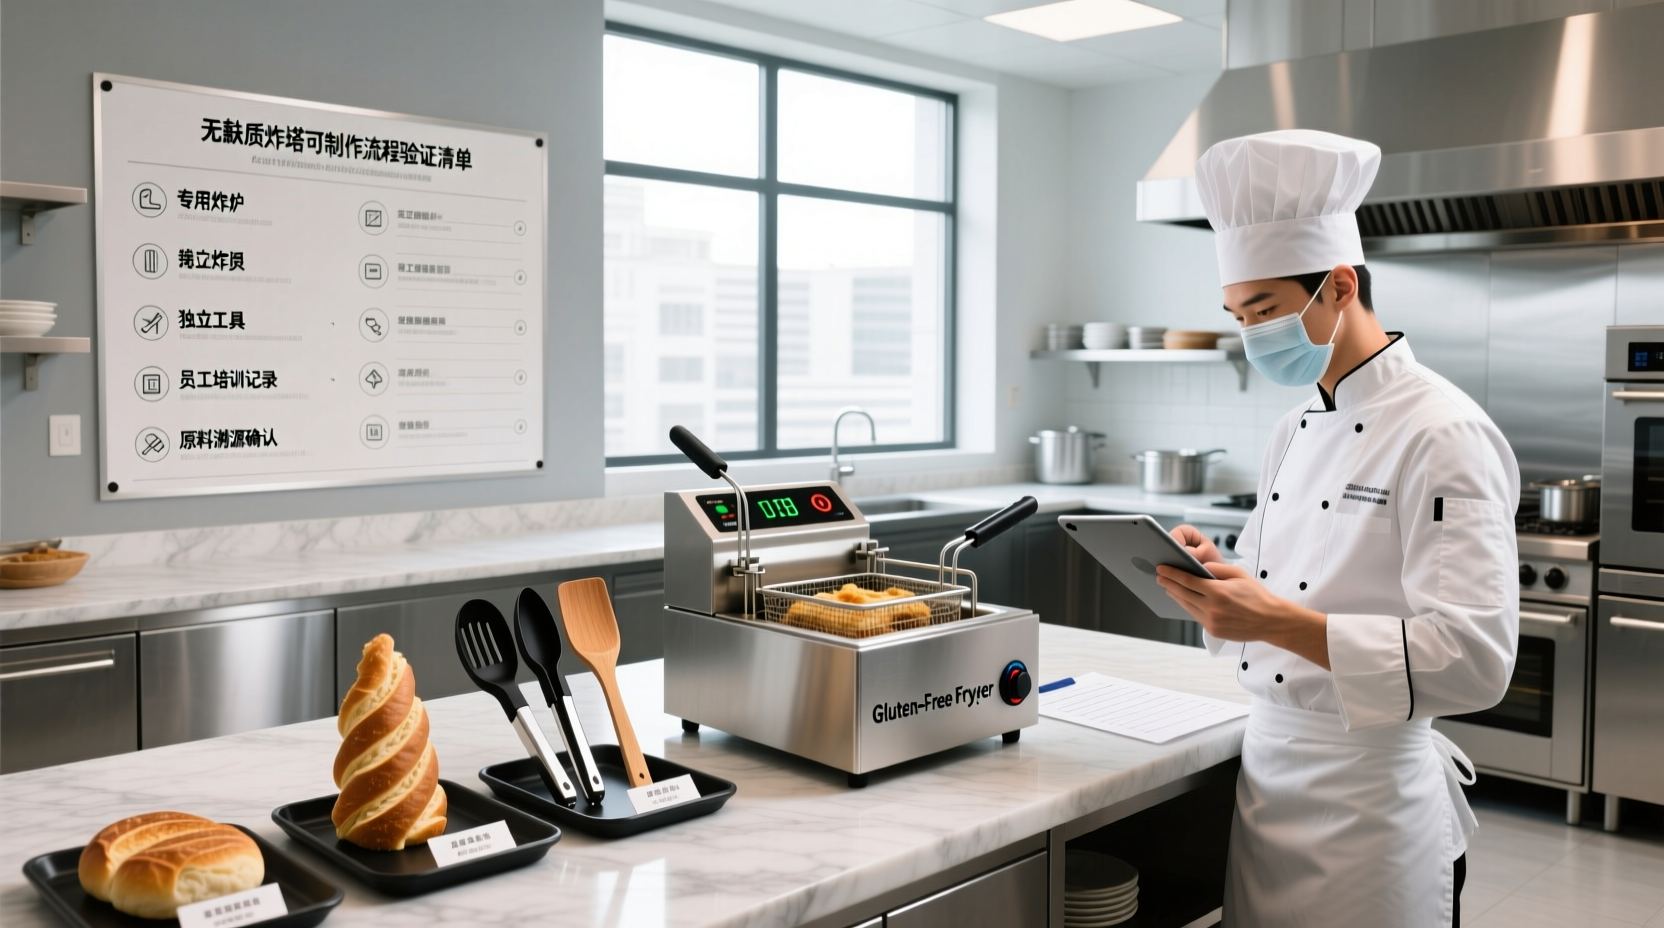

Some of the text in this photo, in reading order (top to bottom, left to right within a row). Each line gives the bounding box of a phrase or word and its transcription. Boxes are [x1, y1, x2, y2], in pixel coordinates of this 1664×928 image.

[177, 188, 244, 213] 专用炸炉
[178, 309, 245, 330] 独立工具
[179, 369, 278, 389] 员工培训记录
[872, 692, 953, 724] Gluten-Free
